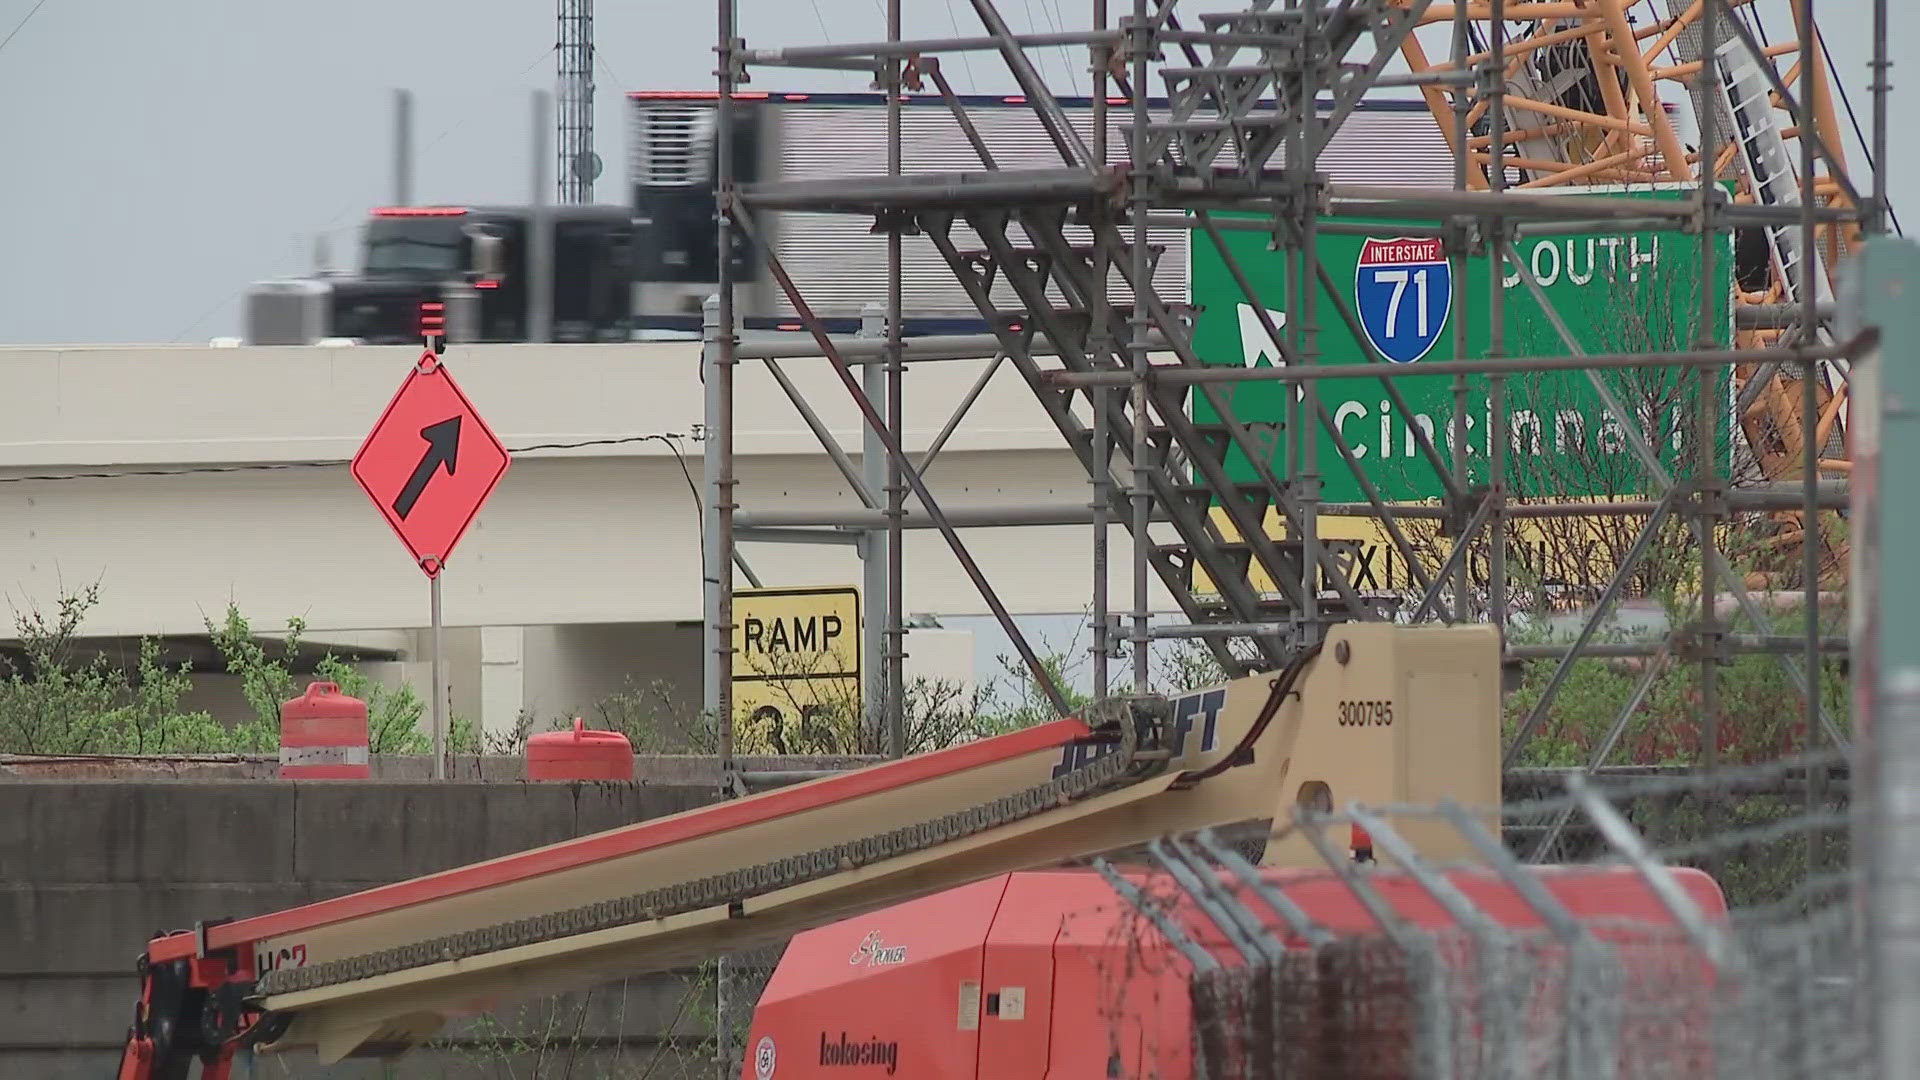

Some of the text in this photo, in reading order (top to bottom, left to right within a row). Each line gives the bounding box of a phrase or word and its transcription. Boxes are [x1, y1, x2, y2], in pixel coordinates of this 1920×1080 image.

[1370, 244, 1436, 262] INTERSTATE
[1374, 269, 1428, 338] 71
[744, 615, 842, 653] RAMP
[1338, 700, 1393, 726] 300795
[820, 1031, 898, 1076] kokosing
